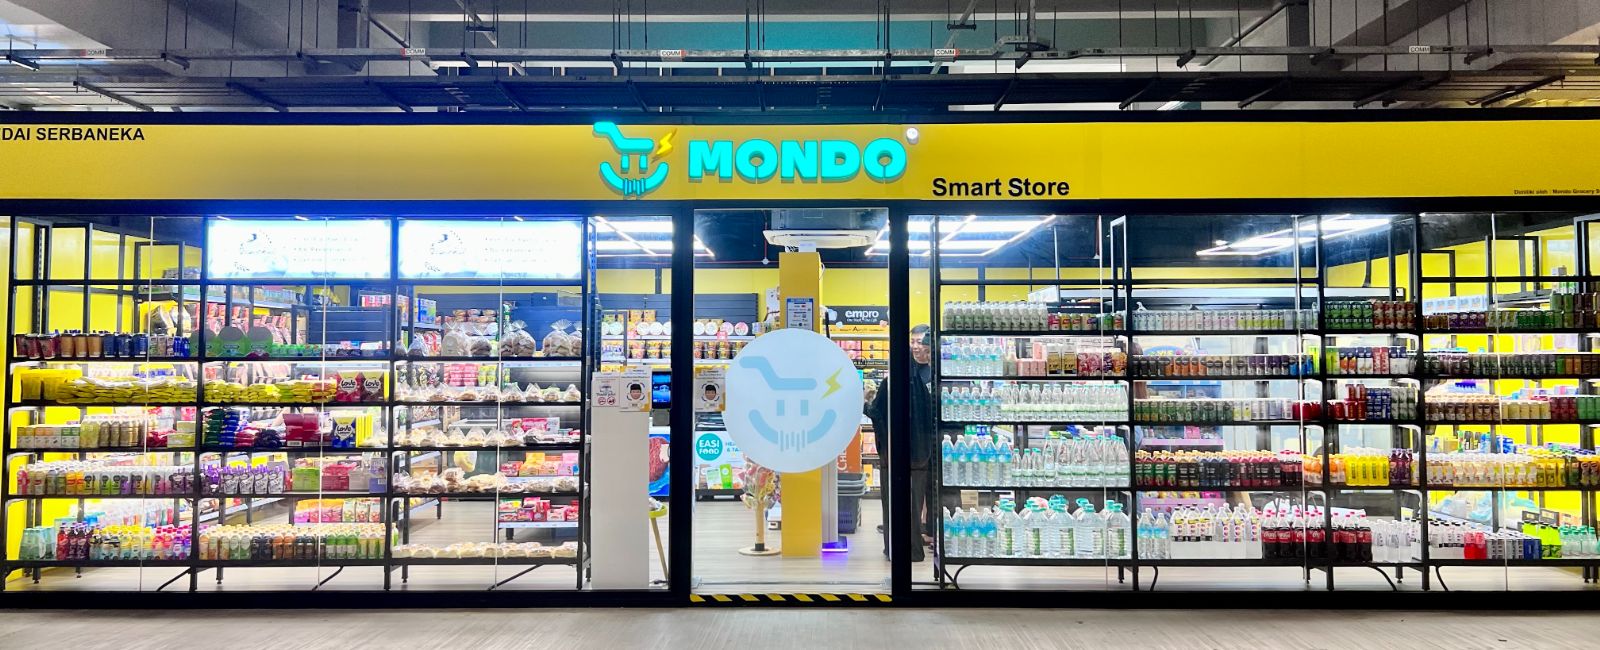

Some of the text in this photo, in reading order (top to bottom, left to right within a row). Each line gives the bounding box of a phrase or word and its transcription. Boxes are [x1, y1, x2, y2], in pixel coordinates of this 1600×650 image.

[0, 128, 144, 140] DAI SERBANEKA
[688, 138, 907, 183] MONDO
[932, 178, 1070, 196] Smart Store
[845, 310, 880, 320] empro
[699, 440, 720, 448] EASI
